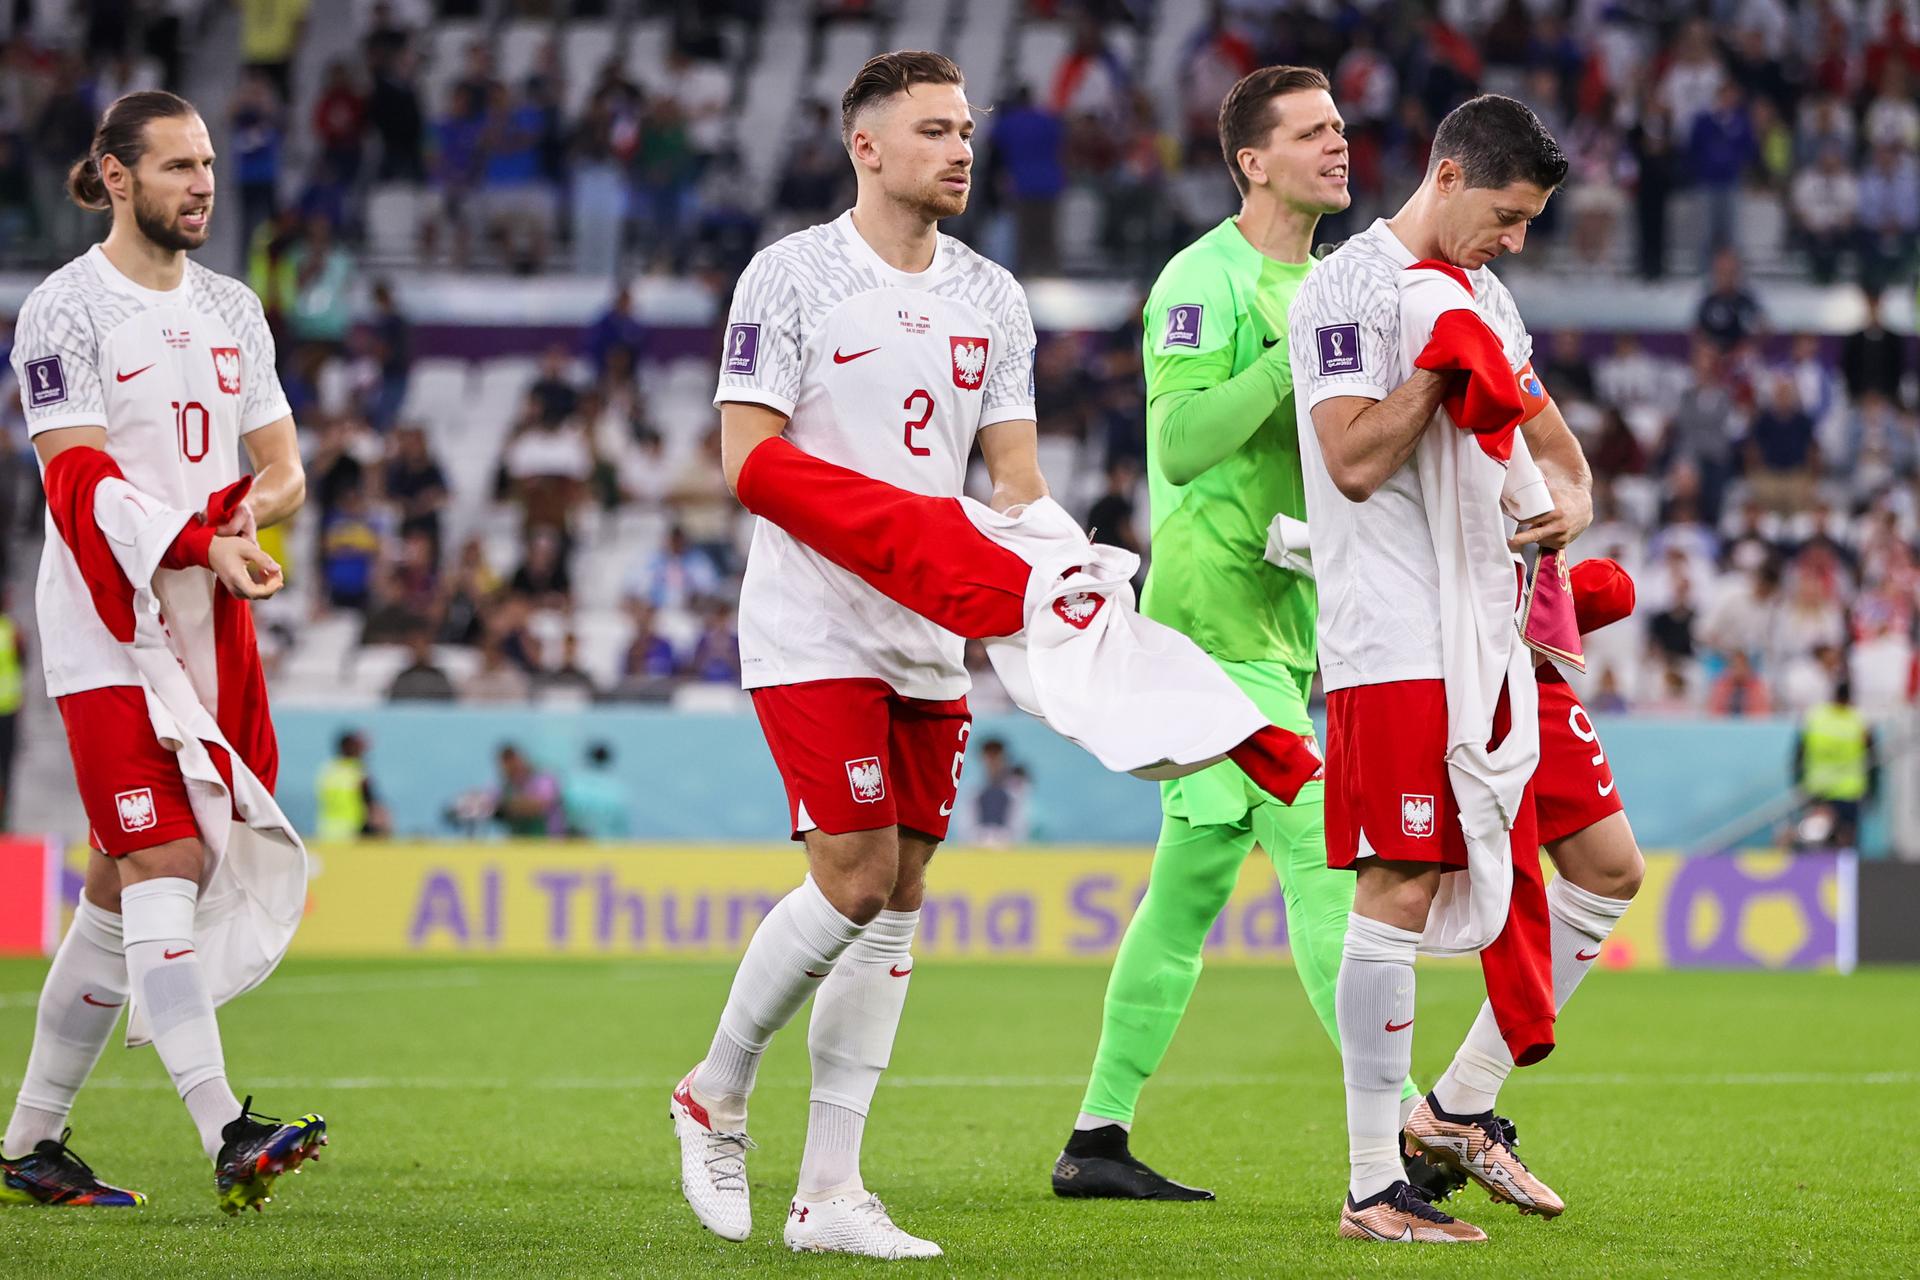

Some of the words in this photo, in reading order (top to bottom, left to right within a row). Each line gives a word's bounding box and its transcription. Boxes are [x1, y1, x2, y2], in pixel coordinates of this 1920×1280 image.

[171, 401, 209, 463] 10
[903, 388, 935, 456] 2
[1568, 704, 1605, 767] 9
[408, 864, 501, 948] Al
